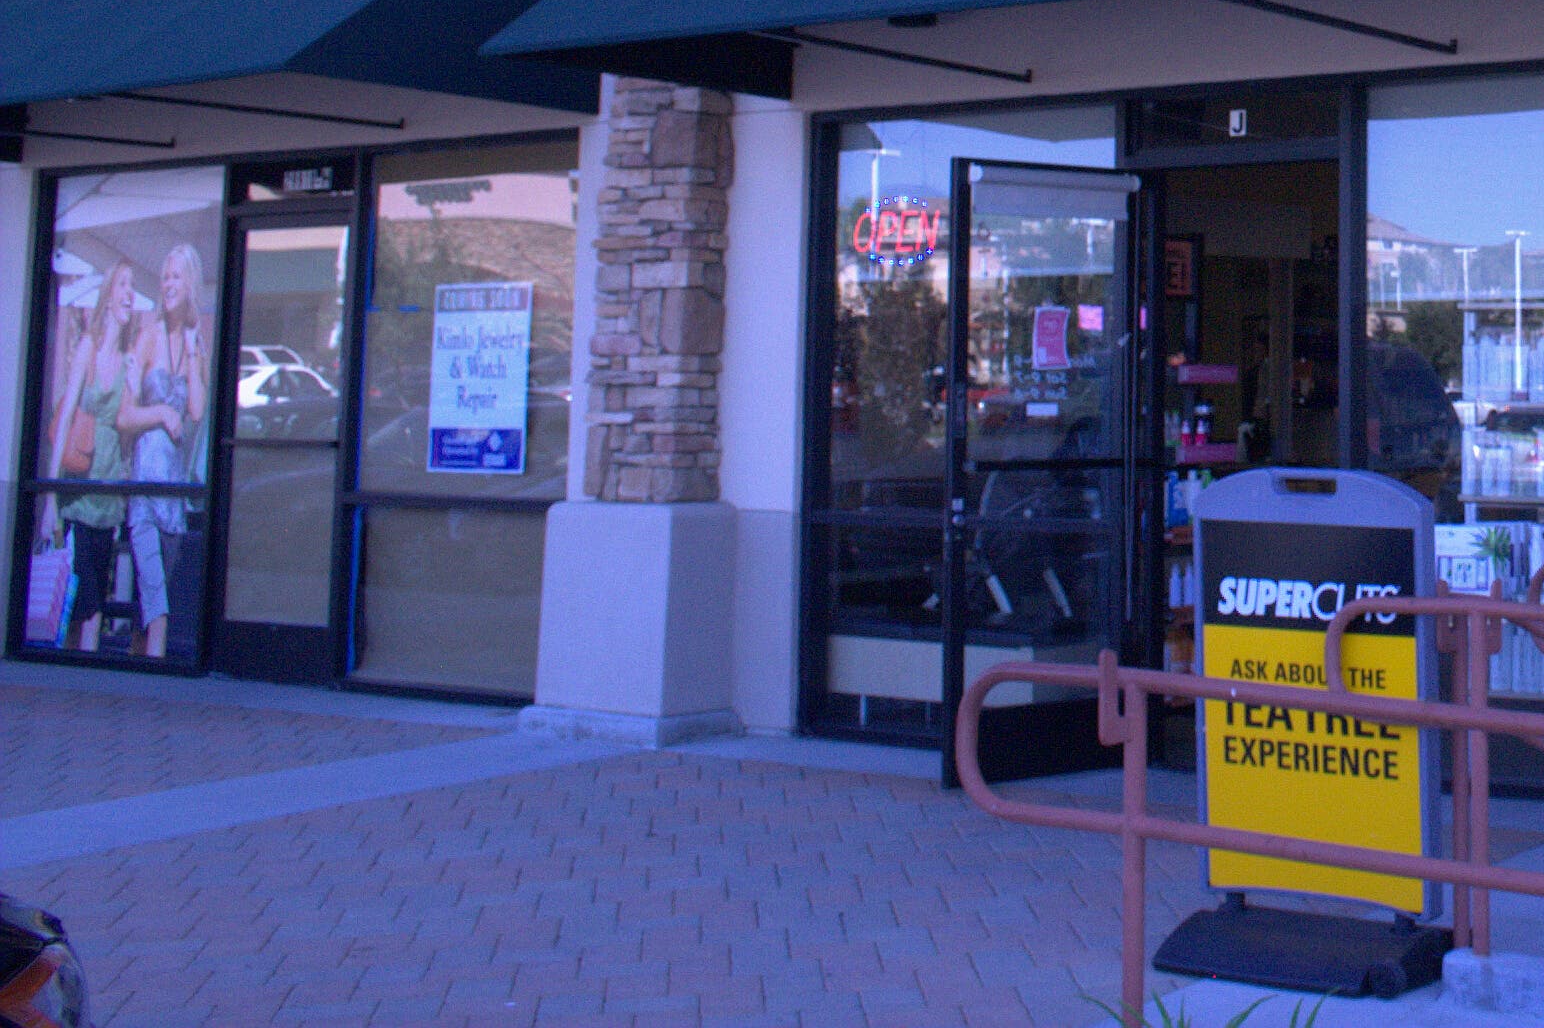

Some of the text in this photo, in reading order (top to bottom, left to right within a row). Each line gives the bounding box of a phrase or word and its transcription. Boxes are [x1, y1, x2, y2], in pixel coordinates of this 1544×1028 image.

[1231, 111, 1244, 134] J
[853, 210, 940, 253] OPEN
[467, 354, 508, 379] Watch
[456, 384, 497, 415] Repair
[1230, 658, 1387, 690] ASK ABOU THE
[1223, 735, 1399, 781] EXPERIENCE
